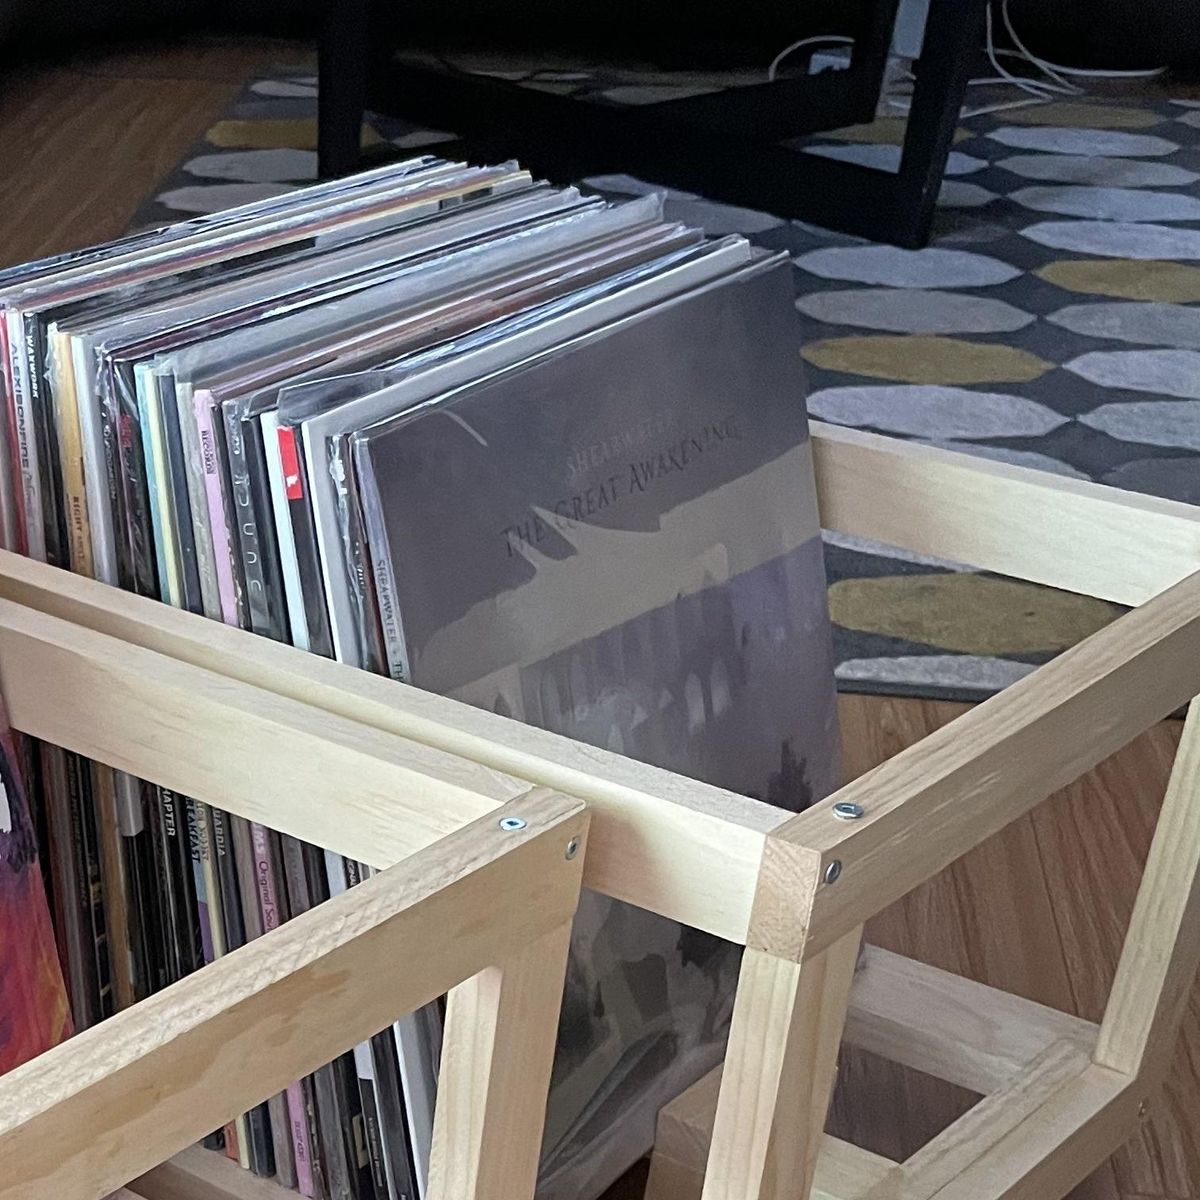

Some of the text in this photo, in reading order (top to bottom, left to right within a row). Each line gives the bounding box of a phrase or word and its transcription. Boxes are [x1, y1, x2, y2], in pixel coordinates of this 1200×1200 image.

[25, 335, 40, 399] WAXWORK
[500, 420, 743, 557] THE GREAT AWAKENING
[377, 560, 398, 642] SHEARWATER
[258, 859, 274, 908] Original
